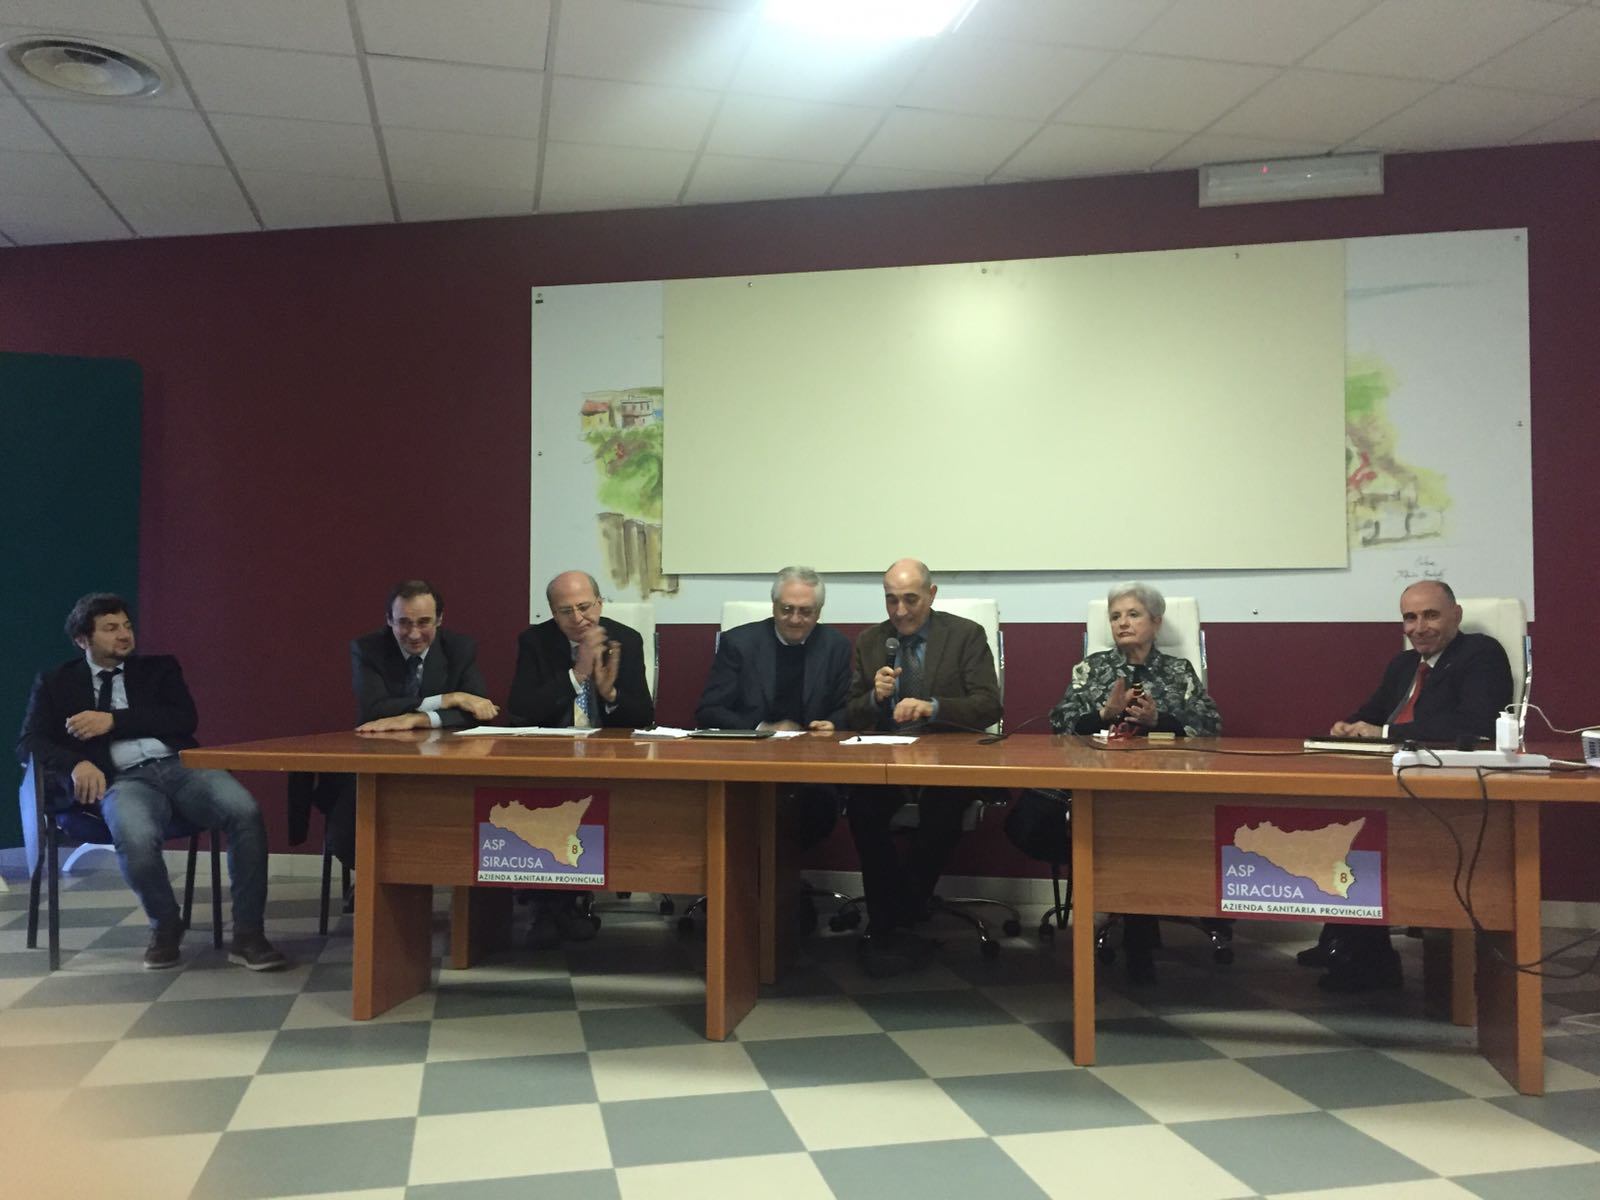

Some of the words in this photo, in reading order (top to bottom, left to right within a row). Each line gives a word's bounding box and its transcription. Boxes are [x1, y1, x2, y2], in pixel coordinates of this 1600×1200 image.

[482, 839, 506, 850] ASP
[571, 845, 578, 854] 8
[482, 856, 544, 869] SIRACUSA
[1225, 864, 1256, 877] ASP
[514, 874, 553, 882] SANITARIA
[555, 875, 604, 884] PROVINCIALE
[1340, 872, 1347, 883] 8
[1226, 883, 1304, 899] SIRACUSA
[1222, 903, 1264, 912] AZIENDA
[1266, 904, 1317, 914] SANITARIA
[1320, 907, 1382, 917] PROVINCIALE
